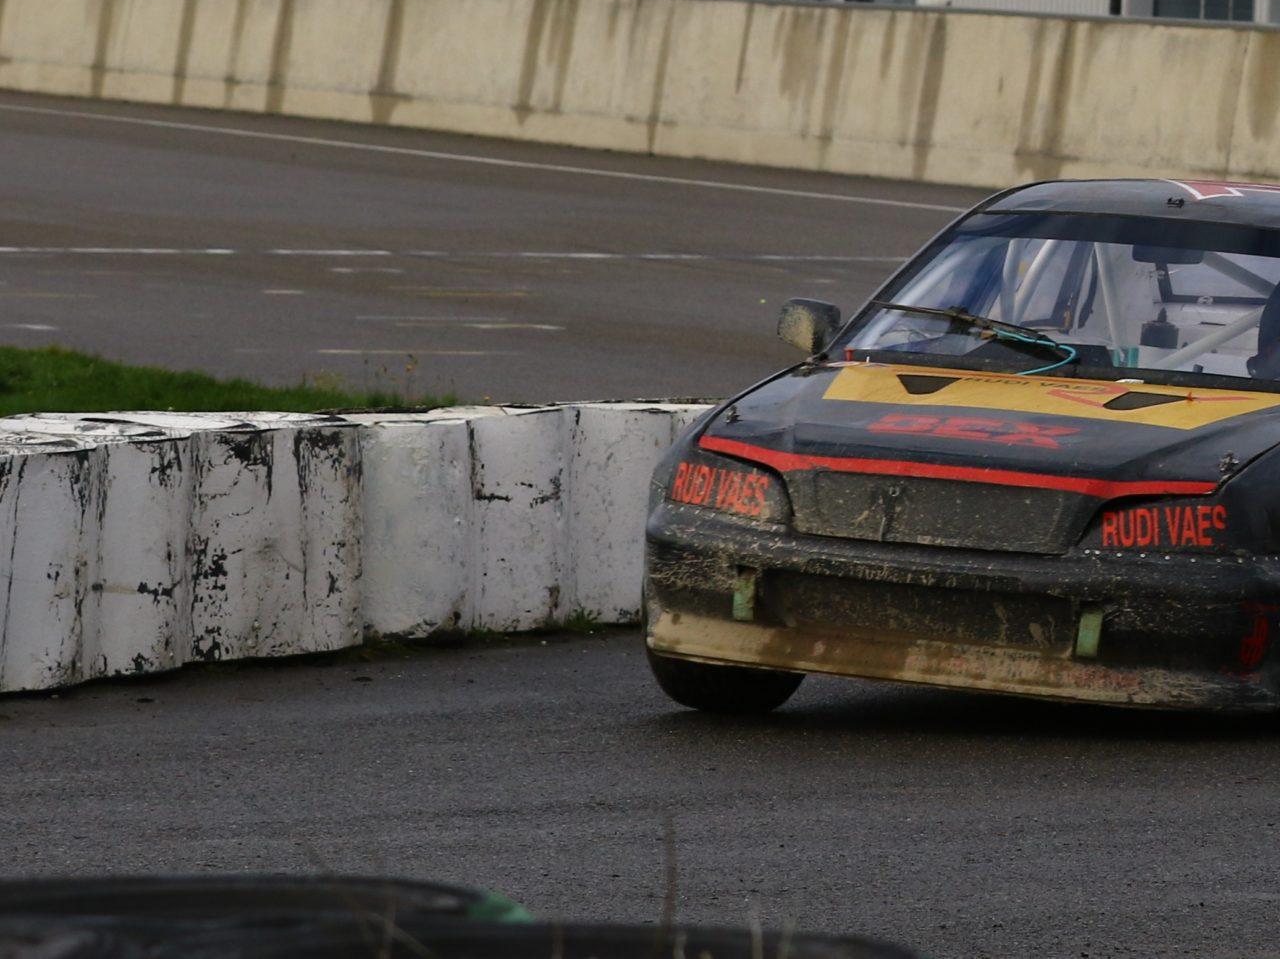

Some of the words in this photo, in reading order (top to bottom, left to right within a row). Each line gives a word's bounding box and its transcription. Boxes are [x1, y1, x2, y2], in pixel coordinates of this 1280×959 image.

[671, 462, 717, 506] RUDI
[715, 467, 769, 517] VAES
[1103, 507, 1160, 548] RUDI
[1164, 504, 1227, 548] VAES
